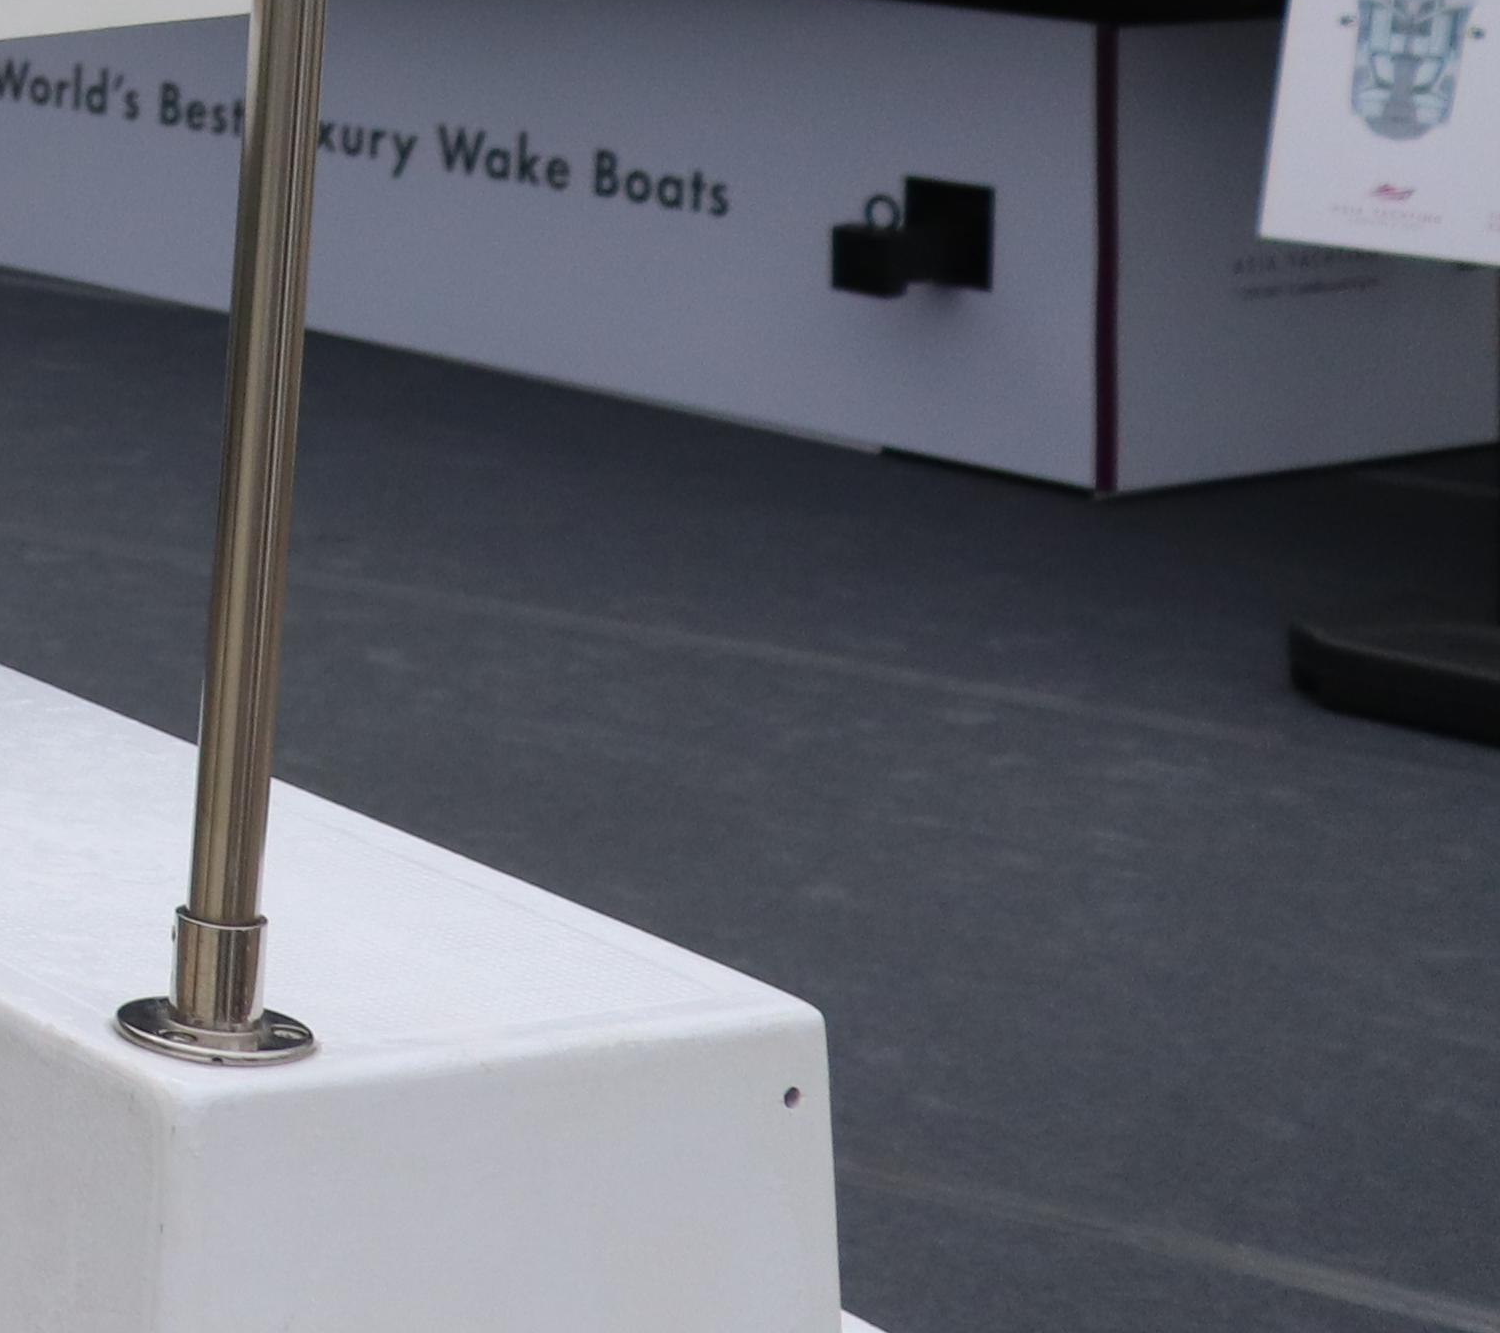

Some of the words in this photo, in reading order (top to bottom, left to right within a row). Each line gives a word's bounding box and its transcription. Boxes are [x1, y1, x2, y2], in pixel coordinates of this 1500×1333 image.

[158, 81, 244, 136] Best
[315, 116, 418, 179] xury
[436, 123, 571, 190] Wake
[592, 148, 730, 218] Boats
